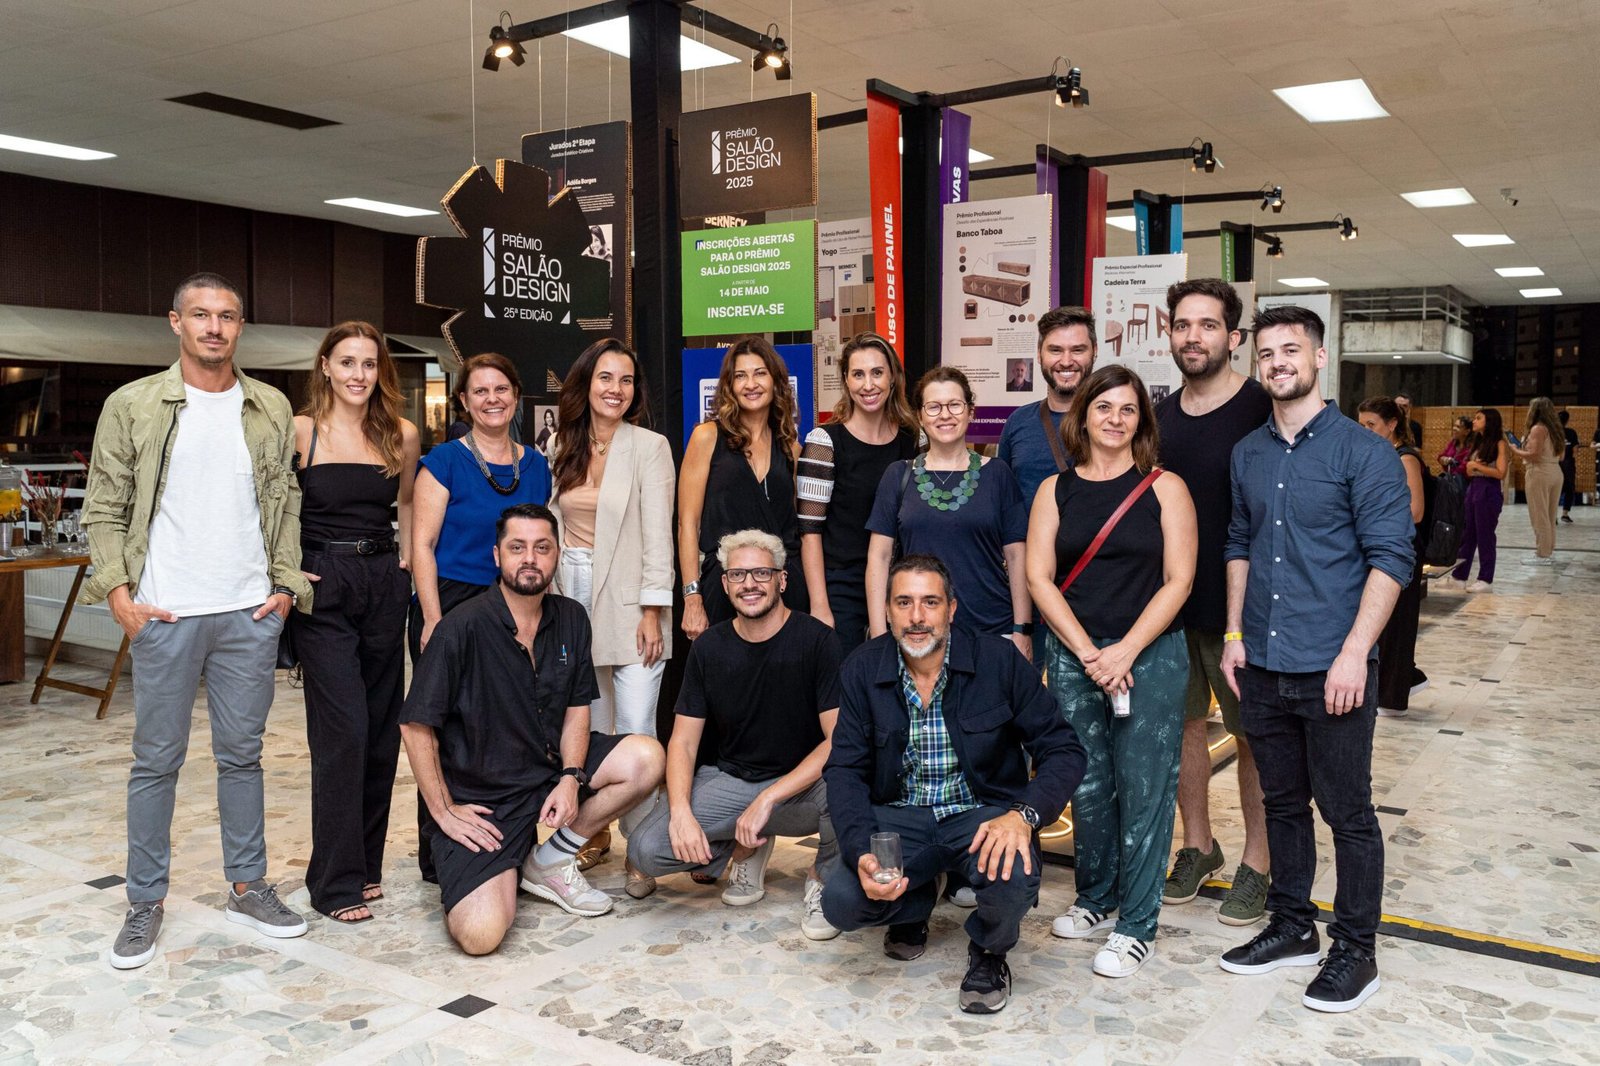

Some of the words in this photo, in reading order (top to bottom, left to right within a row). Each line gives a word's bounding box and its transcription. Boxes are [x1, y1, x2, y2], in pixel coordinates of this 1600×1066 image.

[726, 127, 758, 140] PRÊMIO
[549, 142, 572, 151] Jurados
[579, 138, 596, 147] Etapa
[726, 136, 775, 158] SALÃO
[726, 151, 781, 173] DESIGN
[726, 175, 754, 190] 2025
[974, 209, 1002, 217] Profissional
[884, 203, 895, 271] PAINEL
[956, 230, 980, 238] Banco
[981, 227, 1003, 236] Taboa
[502, 233, 543, 252] PRÊMIO
[697, 237, 751, 251] INSCRIÇÕES
[752, 233, 795, 246] ABERTAS
[710, 252, 735, 263] PARA
[736, 251, 743, 261] O
[744, 248, 781, 260] PRÊMIO
[821, 249, 838, 257] Yogo
[502, 252, 563, 280] SALÃO
[700, 264, 731, 276] SALÃO
[732, 263, 767, 275] DESIGN
[767, 261, 791, 272] 2025
[502, 275, 571, 304] DESIGN
[886, 273, 896, 300] DE
[1129, 278, 1146, 286] Terra
[719, 288, 731, 298] 14
[731, 287, 744, 297] DE
[744, 285, 770, 296] MAIO
[520, 308, 553, 323] EDIÇÃO
[707, 302, 785, 319] INSCREVA-SE
[887, 302, 897, 344] USO
